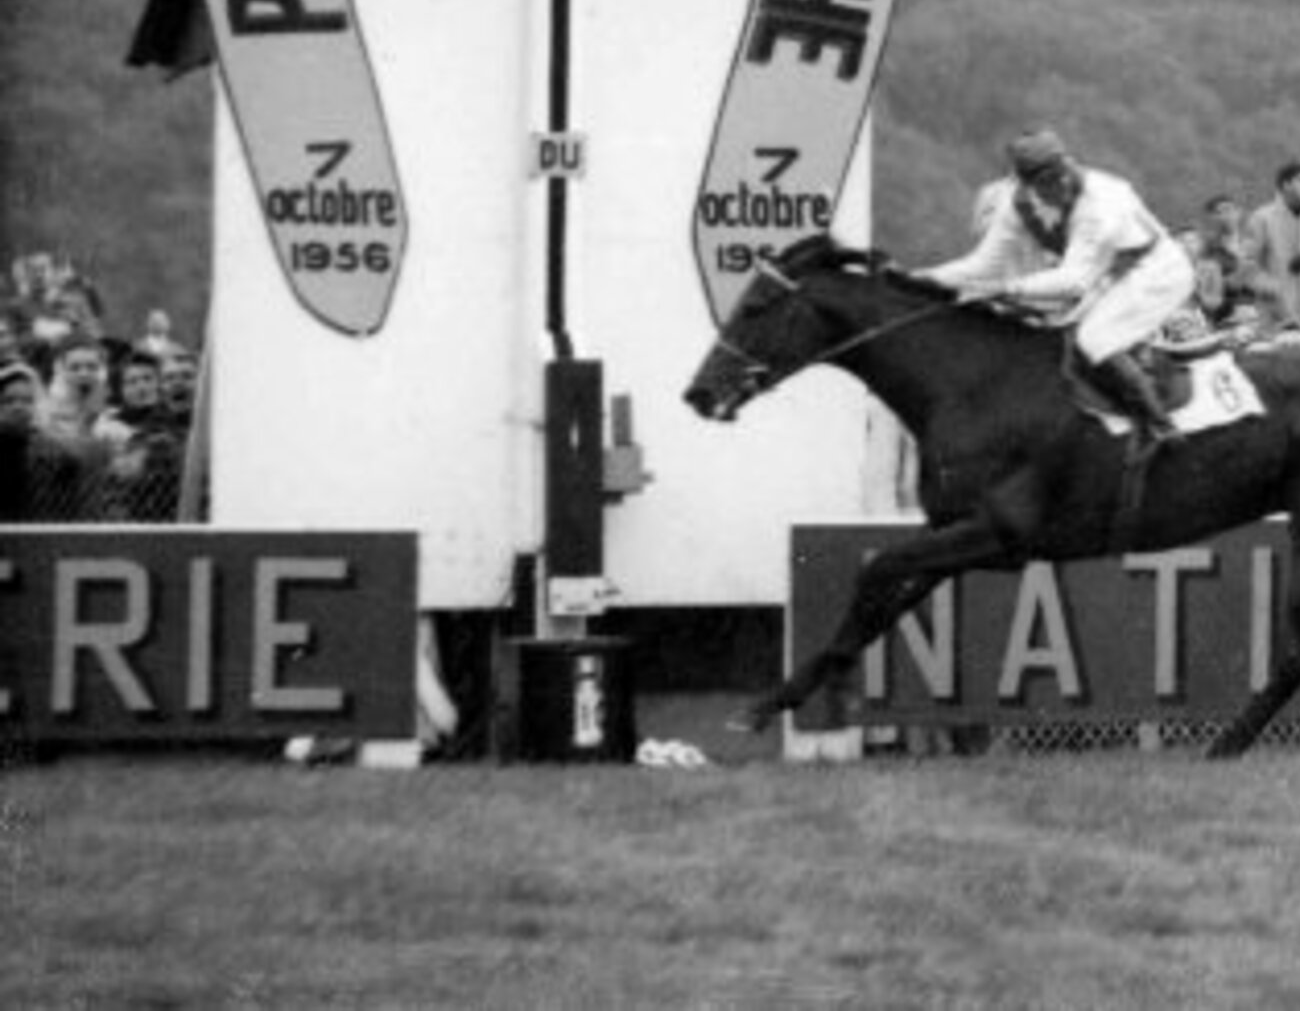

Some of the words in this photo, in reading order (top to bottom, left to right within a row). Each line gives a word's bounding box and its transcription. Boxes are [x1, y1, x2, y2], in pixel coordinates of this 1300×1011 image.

[305, 141, 353, 180] 7
[539, 139, 581, 171] DU
[754, 147, 799, 184] 7
[267, 179, 398, 228] octobre
[702, 182, 830, 230] octobre
[291, 241, 391, 274] 1956
[0, 557, 348, 713] RIE
